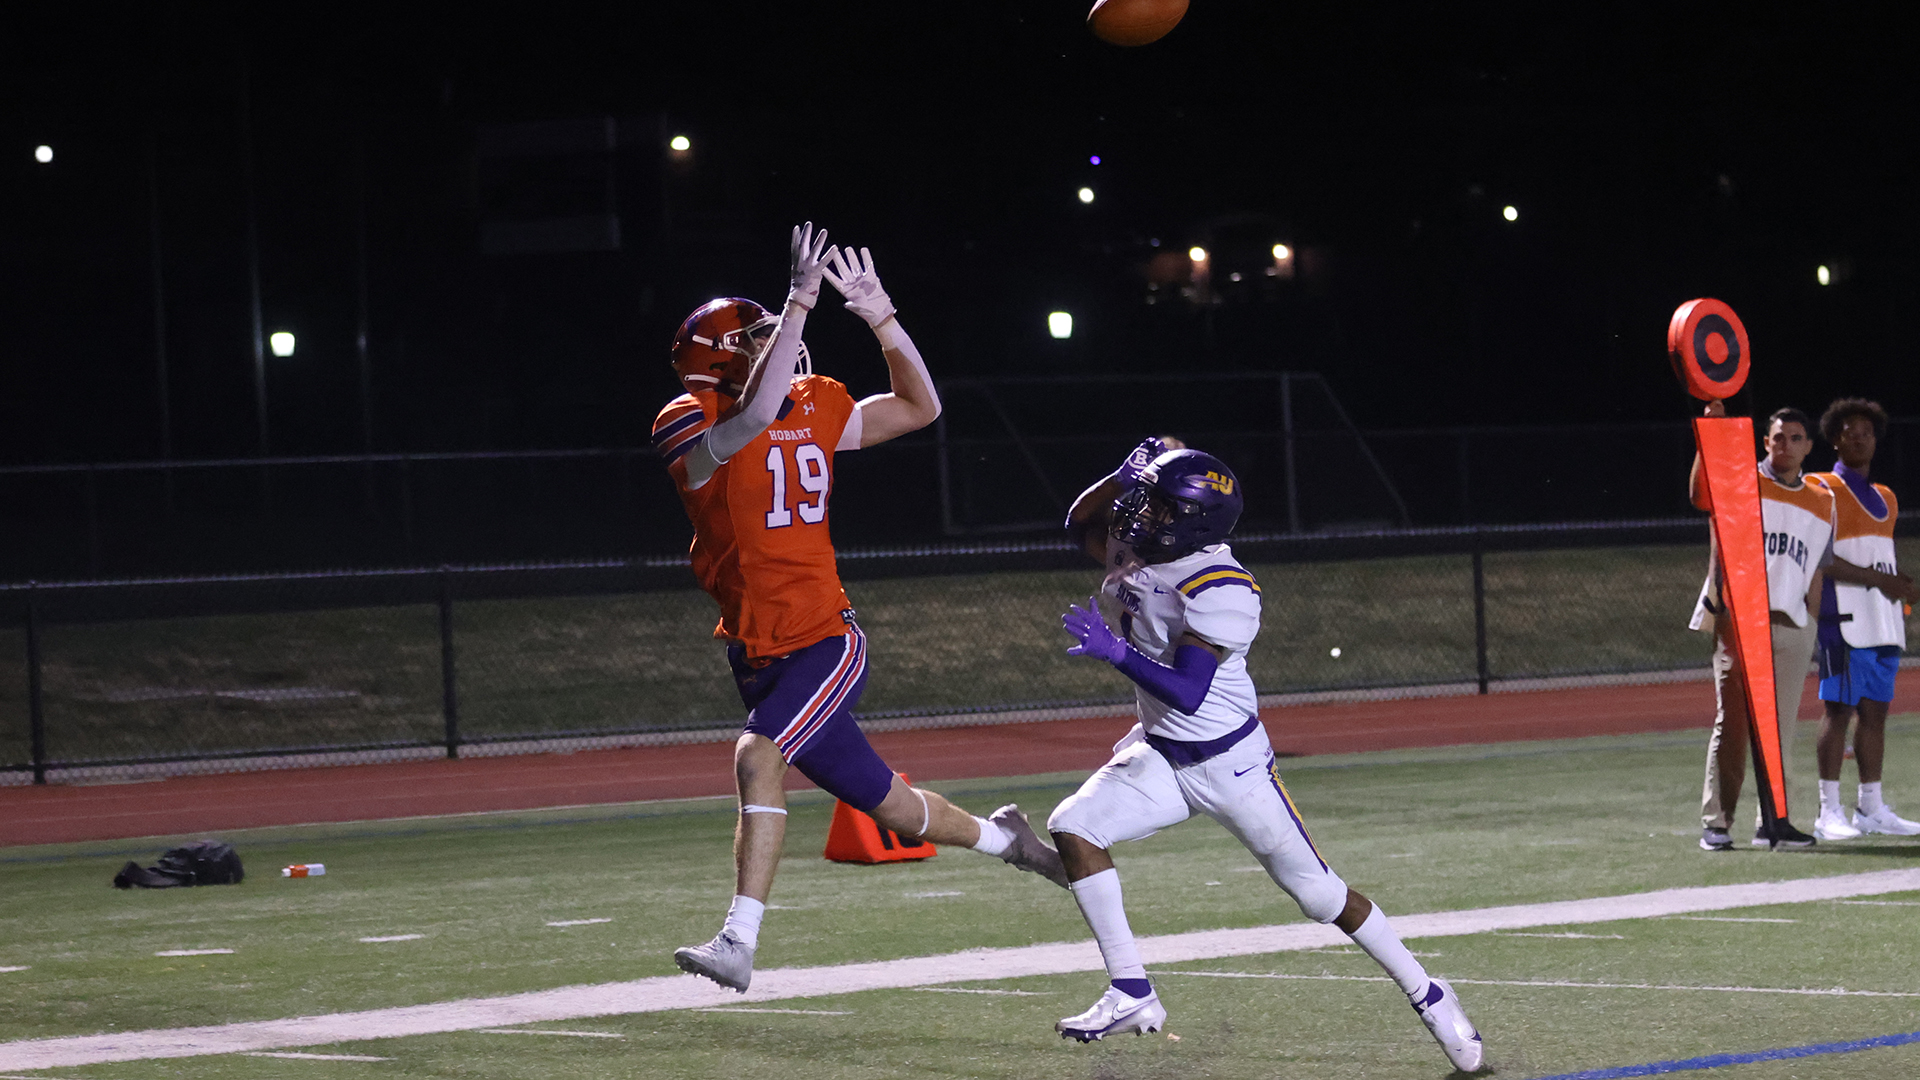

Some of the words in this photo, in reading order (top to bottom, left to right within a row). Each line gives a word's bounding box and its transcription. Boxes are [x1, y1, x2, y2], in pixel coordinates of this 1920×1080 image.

[768, 427, 812, 441] HOBART
[765, 442, 830, 530] 19
[1202, 470, 1234, 495] AU
[1763, 532, 1809, 574] OBART
